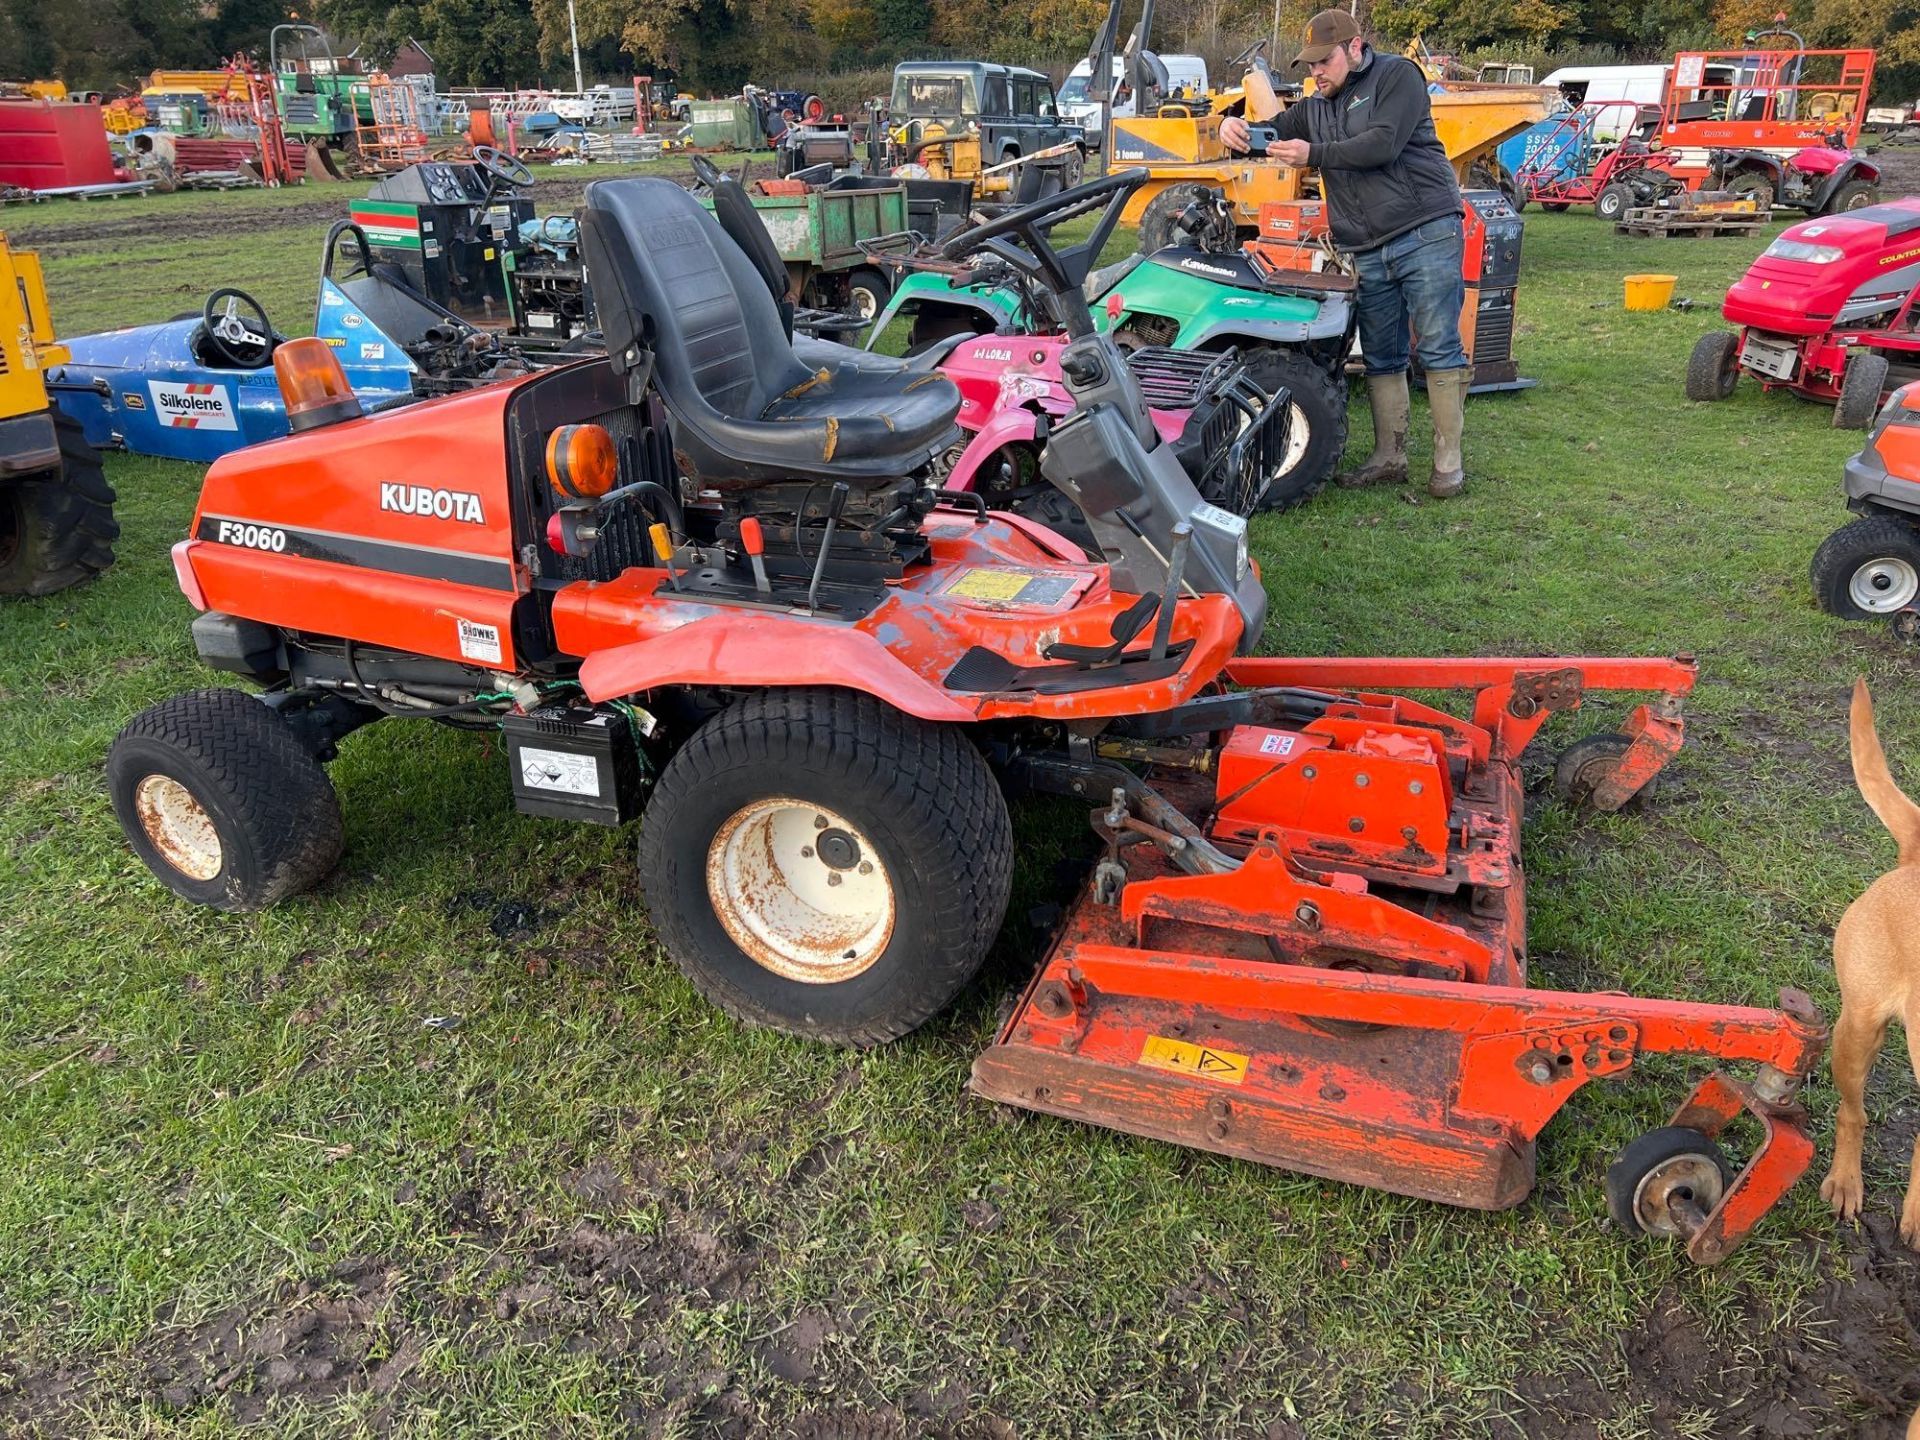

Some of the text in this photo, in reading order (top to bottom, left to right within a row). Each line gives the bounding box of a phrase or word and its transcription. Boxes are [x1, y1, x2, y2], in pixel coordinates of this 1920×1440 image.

[1114, 147, 1144, 160] 3 tonne
[1181, 256, 1237, 278] Kawasaki
[159, 393, 223, 411] Silkolene
[380, 481, 486, 525] KUBOTA
[218, 521, 286, 552] F3060
